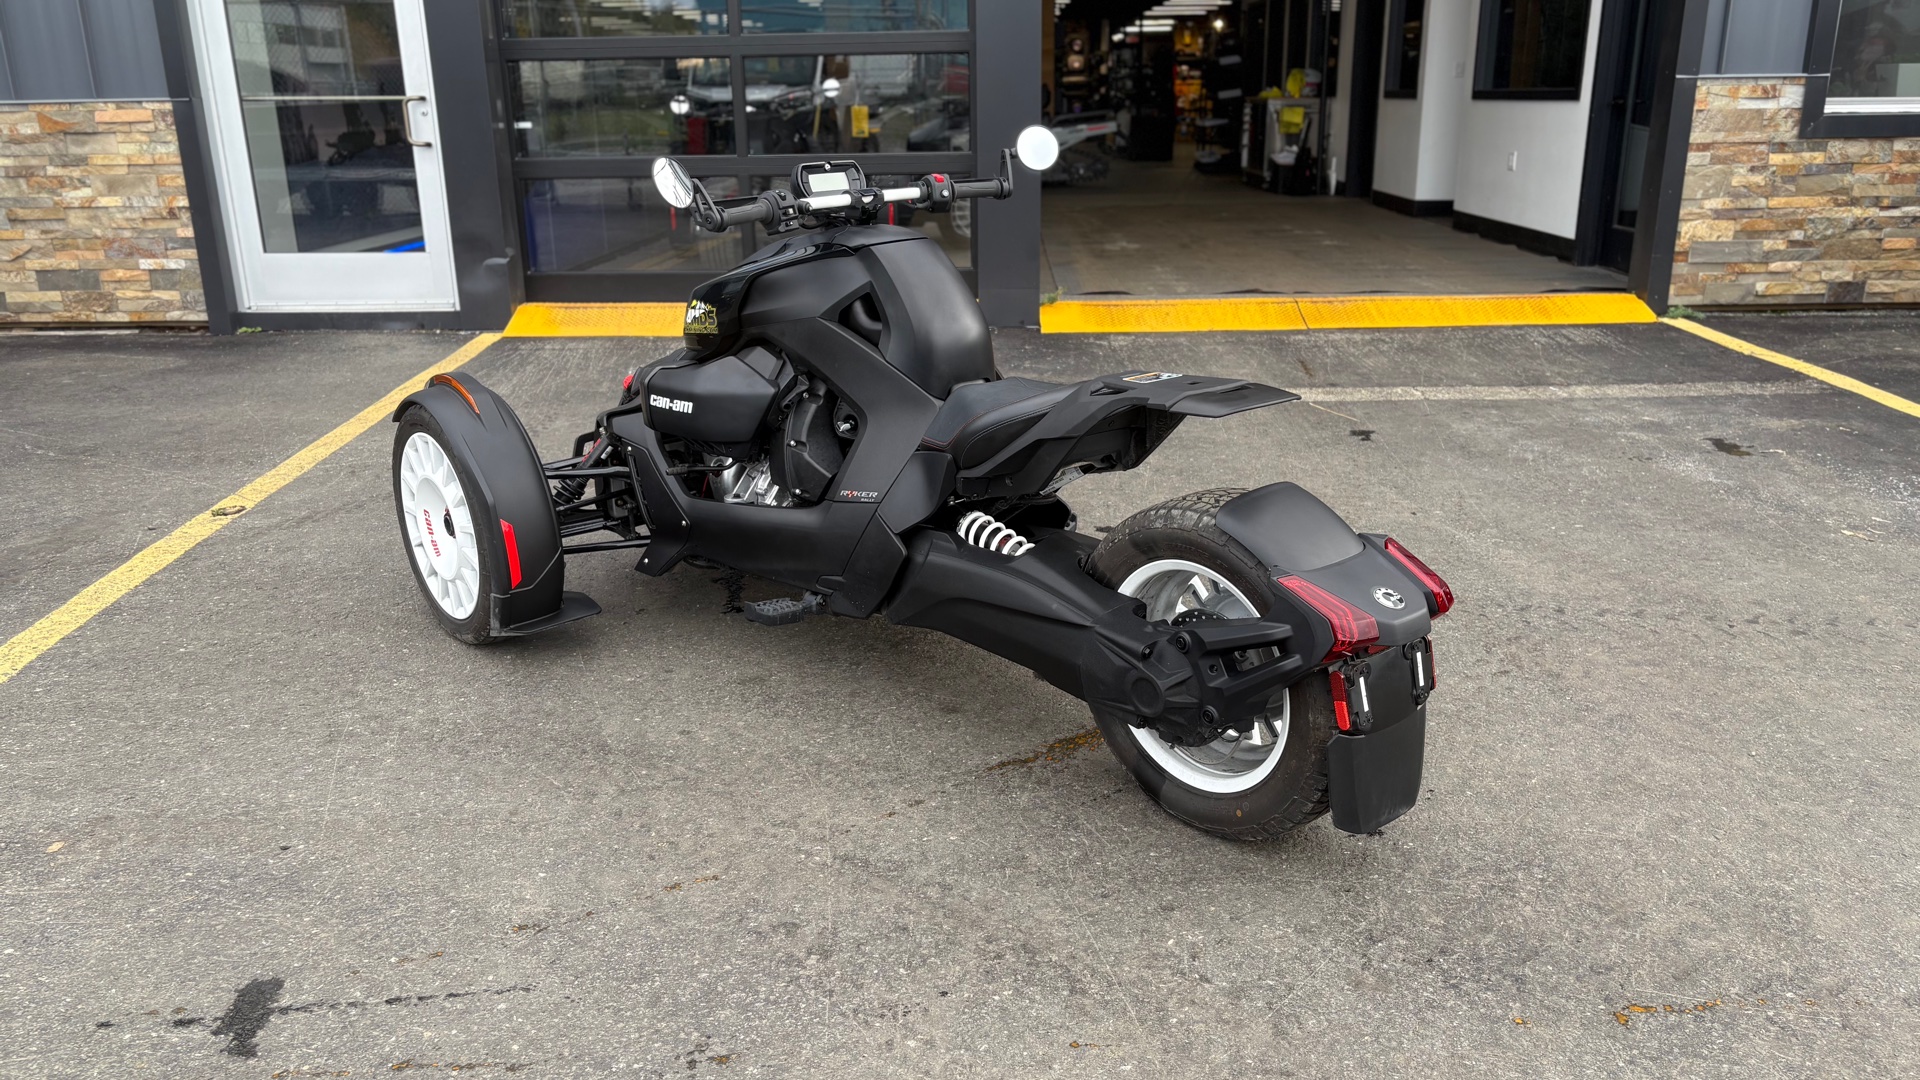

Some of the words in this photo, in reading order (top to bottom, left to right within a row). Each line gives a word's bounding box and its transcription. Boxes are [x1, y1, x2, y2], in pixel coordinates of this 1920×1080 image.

[650, 394, 693, 414] can-am
[840, 490, 878, 498] RYKER
[423, 508, 442, 557] can-am
